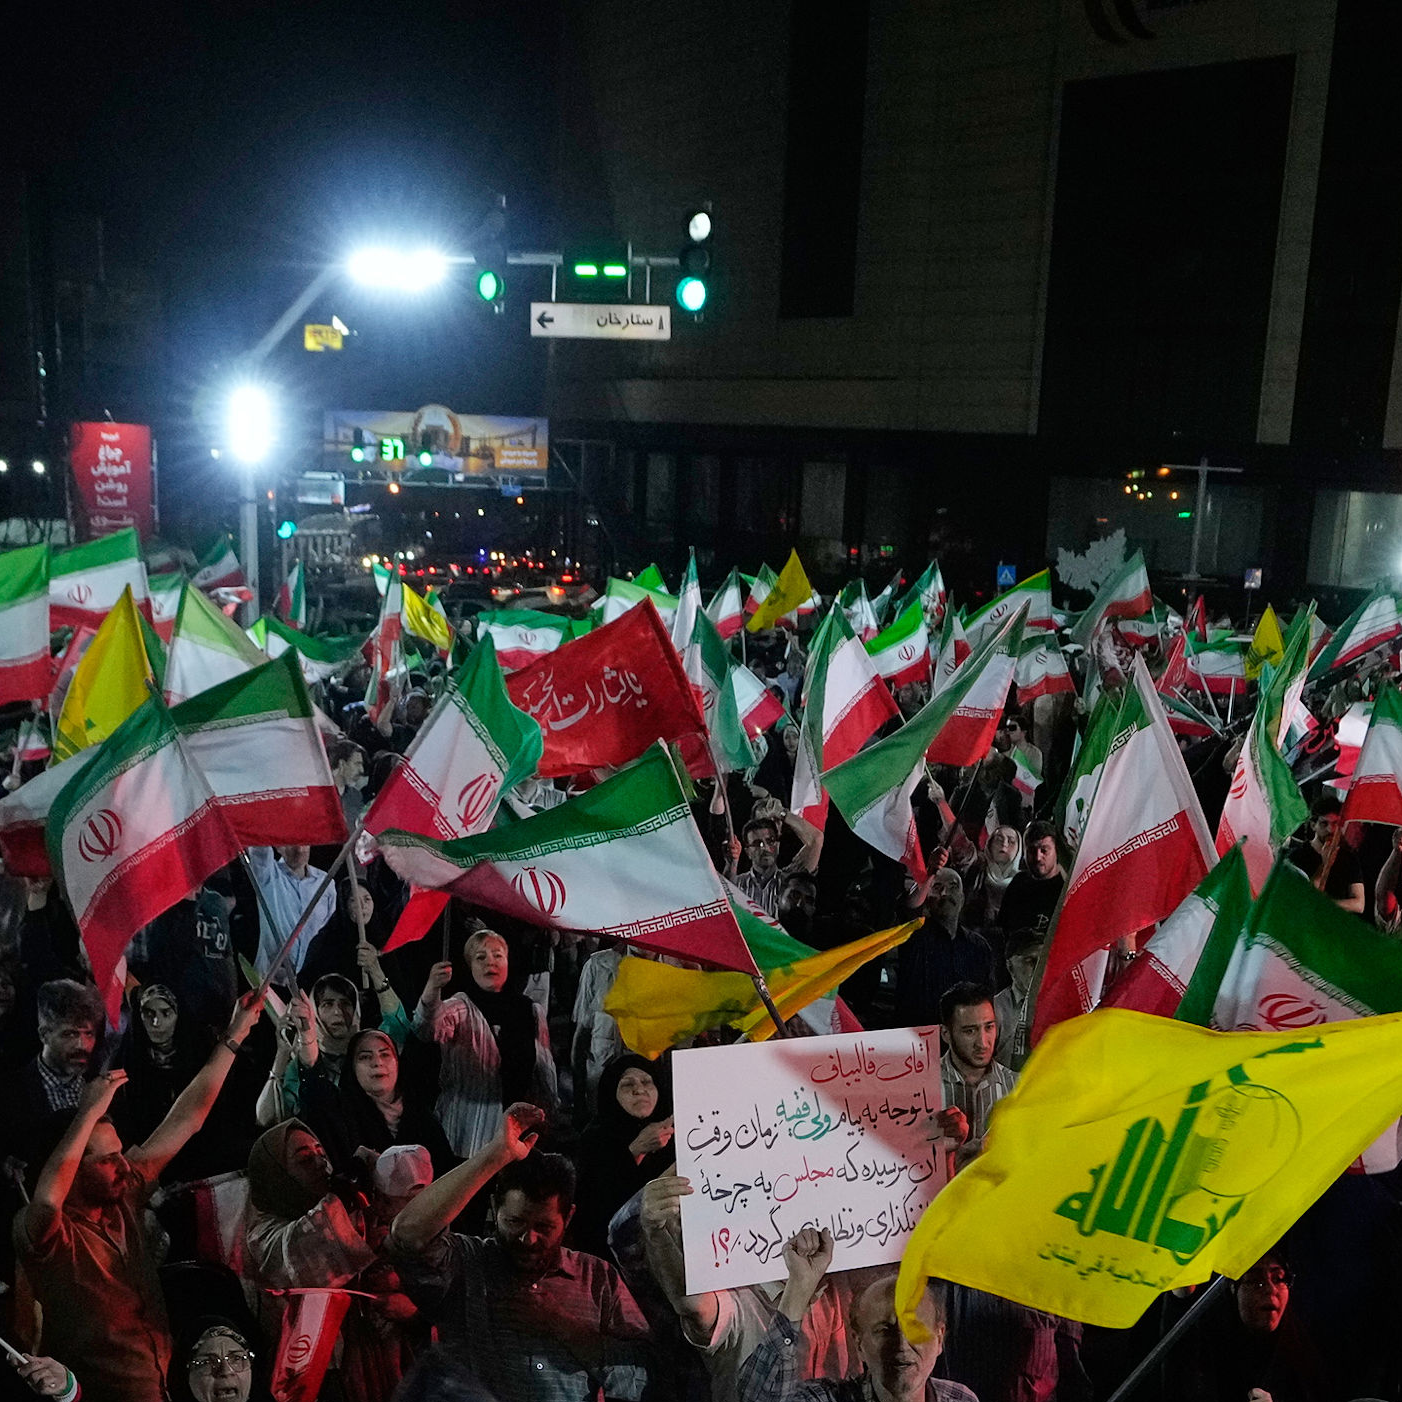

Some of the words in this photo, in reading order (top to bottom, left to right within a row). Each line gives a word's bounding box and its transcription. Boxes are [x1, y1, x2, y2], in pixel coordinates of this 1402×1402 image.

[596, 312, 653, 330] ستارخان
[381, 438, 405, 461] 37
[811, 1040, 876, 1086] قالیباف
[876, 1032, 932, 1081] آقای
[734, 1103, 781, 1150] زمان
[788, 1091, 831, 1141] ولی
[829, 1098, 863, 1137] پیام
[862, 1102, 878, 1129] به
[773, 1155, 835, 1202] مجلس
[836, 1140, 862, 1182] که
[862, 1153, 908, 1188] نرسیده
[908, 1137, 940, 1182] آن
[754, 1170, 774, 1201] به
